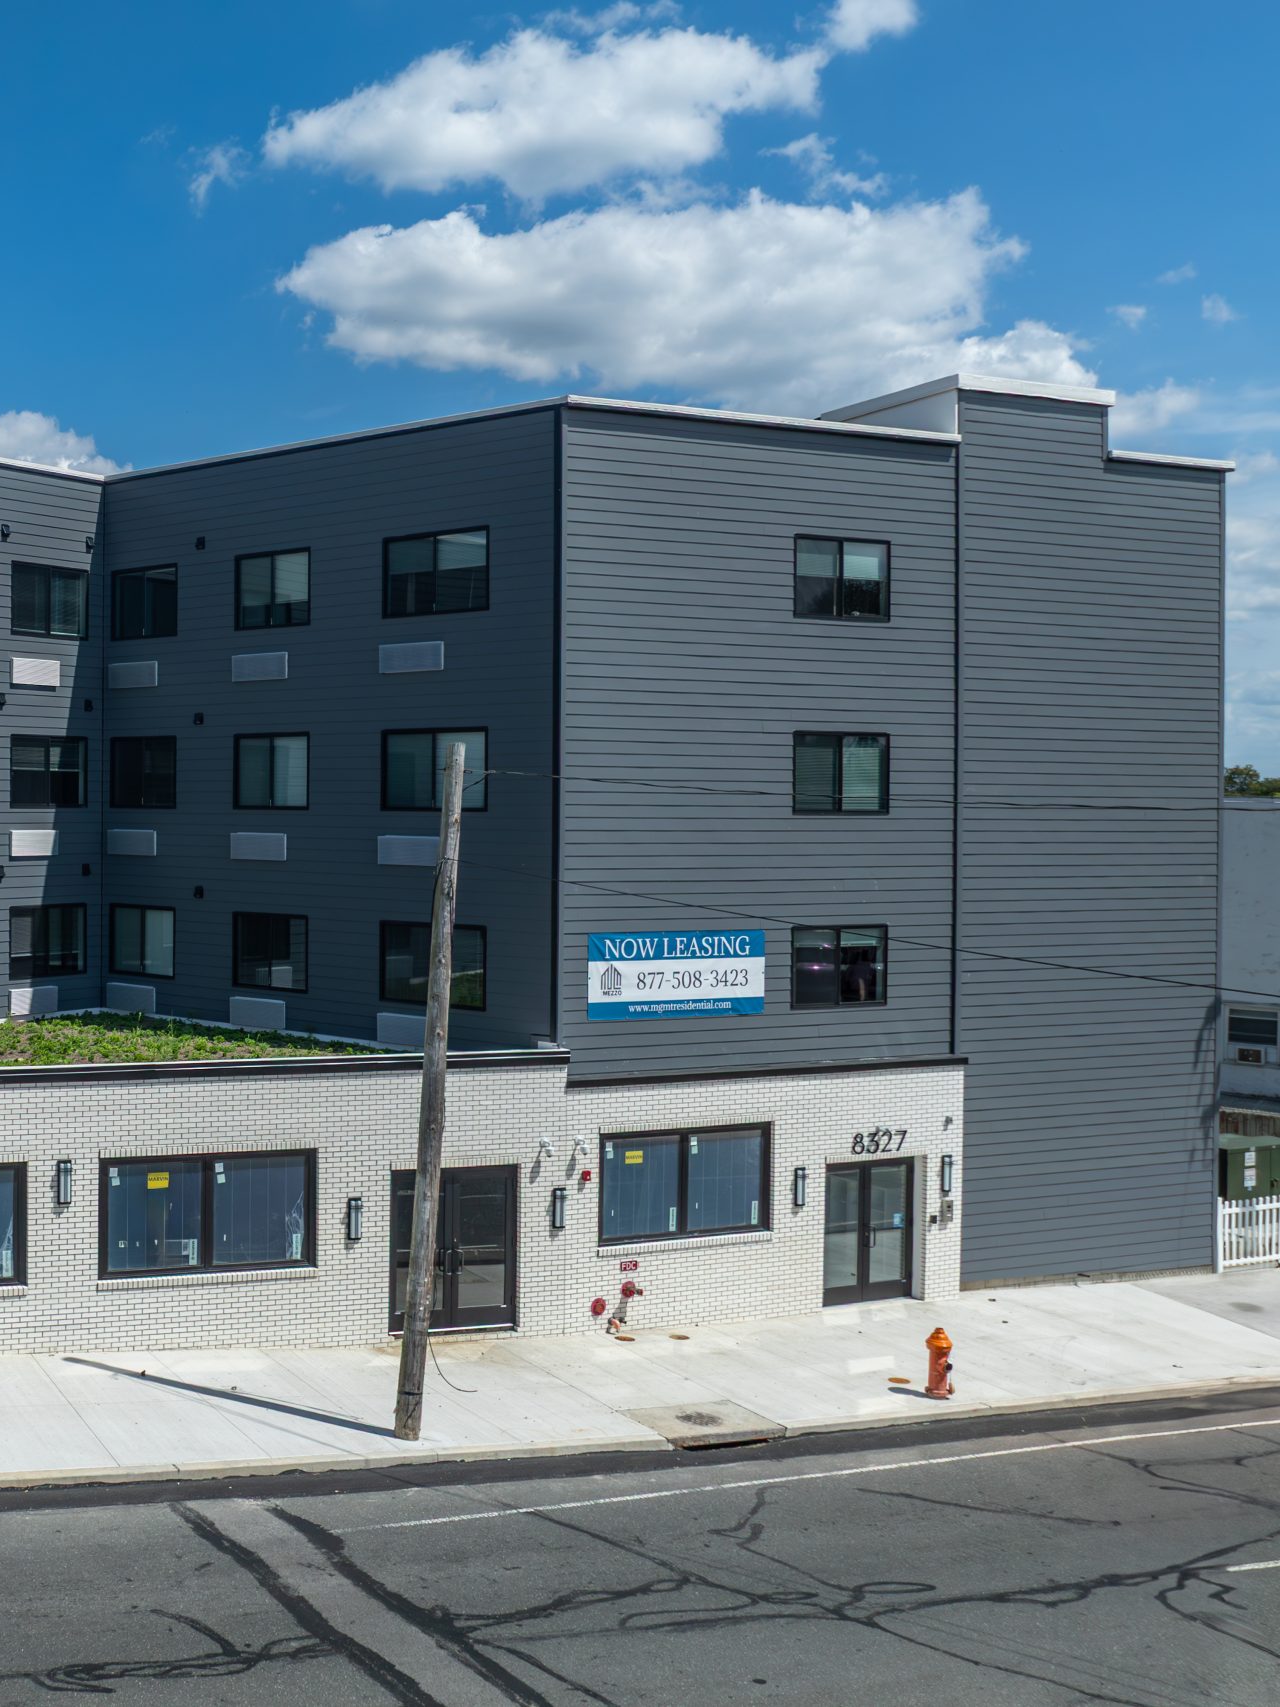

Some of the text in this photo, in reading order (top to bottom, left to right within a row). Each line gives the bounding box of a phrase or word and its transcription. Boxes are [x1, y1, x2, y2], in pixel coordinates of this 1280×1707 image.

[604, 936, 751, 959] NOW LEASING
[636, 968, 749, 990] 877-508-3423
[628, 1000, 732, 1014] www.mgmtresidential.com
[851, 1130, 908, 1155] 8327
[621, 1261, 636, 1271] FDC
